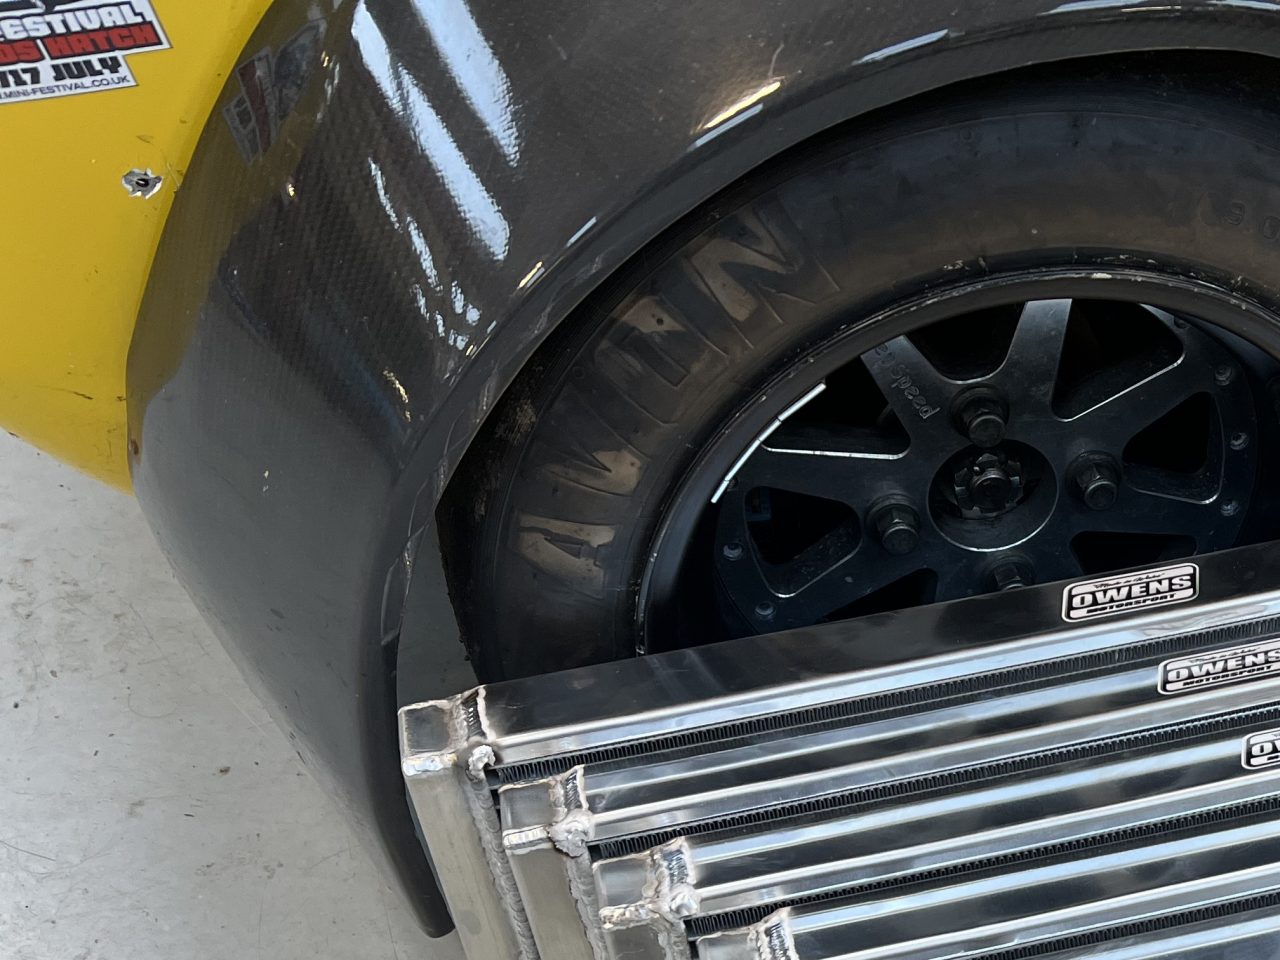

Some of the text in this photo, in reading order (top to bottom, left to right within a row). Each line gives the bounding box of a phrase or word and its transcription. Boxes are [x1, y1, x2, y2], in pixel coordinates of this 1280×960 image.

[0, 3, 143, 40] ESTIVAL
[42, 23, 158, 58] HATCH
[51, 56, 121, 81] JULY
[0, 75, 131, 99] .MINI-FESTIVAL.CO.UK
[1072, 575, 1192, 608] OWENS
